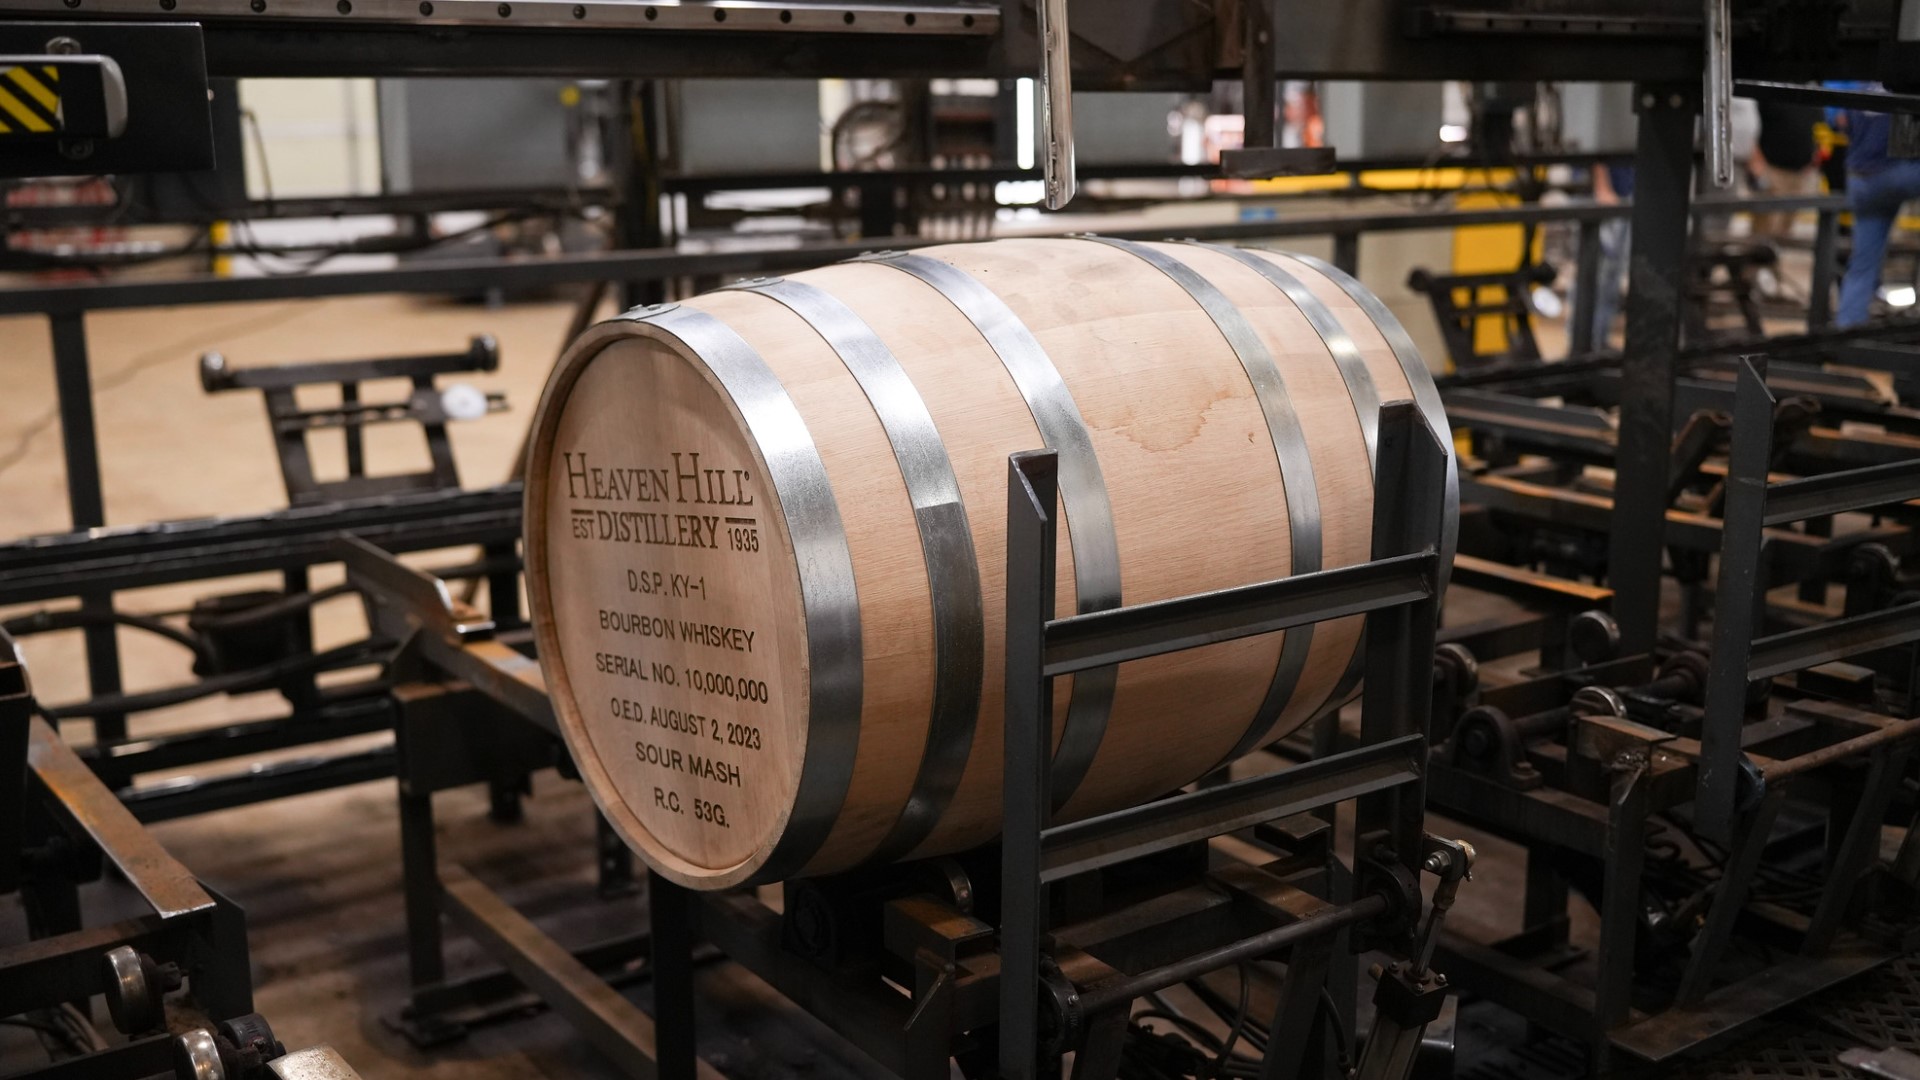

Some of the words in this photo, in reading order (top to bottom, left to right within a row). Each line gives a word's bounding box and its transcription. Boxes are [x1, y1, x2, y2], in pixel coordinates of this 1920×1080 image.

[564, 452, 669, 502] HEAVEN
[572, 518, 595, 539] EST
[597, 510, 719, 549] DISTILLERY
[727, 527, 759, 553] 1935
[627, 569, 668, 596] D.S.P.
[670, 573, 706, 600] KY-1
[599, 609, 674, 640] BOURBON
[679, 620, 754, 652] WHISKEY
[595, 652, 648, 680] SERIAL
[652, 662, 680, 687] NO.
[685, 668, 768, 704] 10,000,000
[611, 697, 647, 724] O.E.D.
[651, 706, 706, 737] AUGUST
[711, 719, 724, 745] 2,
[727, 723, 761, 750] 2023
[635, 741, 684, 772] SOUR
[688, 754, 741, 787] MASH
[654, 786, 684, 814] R.C.
[694, 798, 730, 828] 53G.
